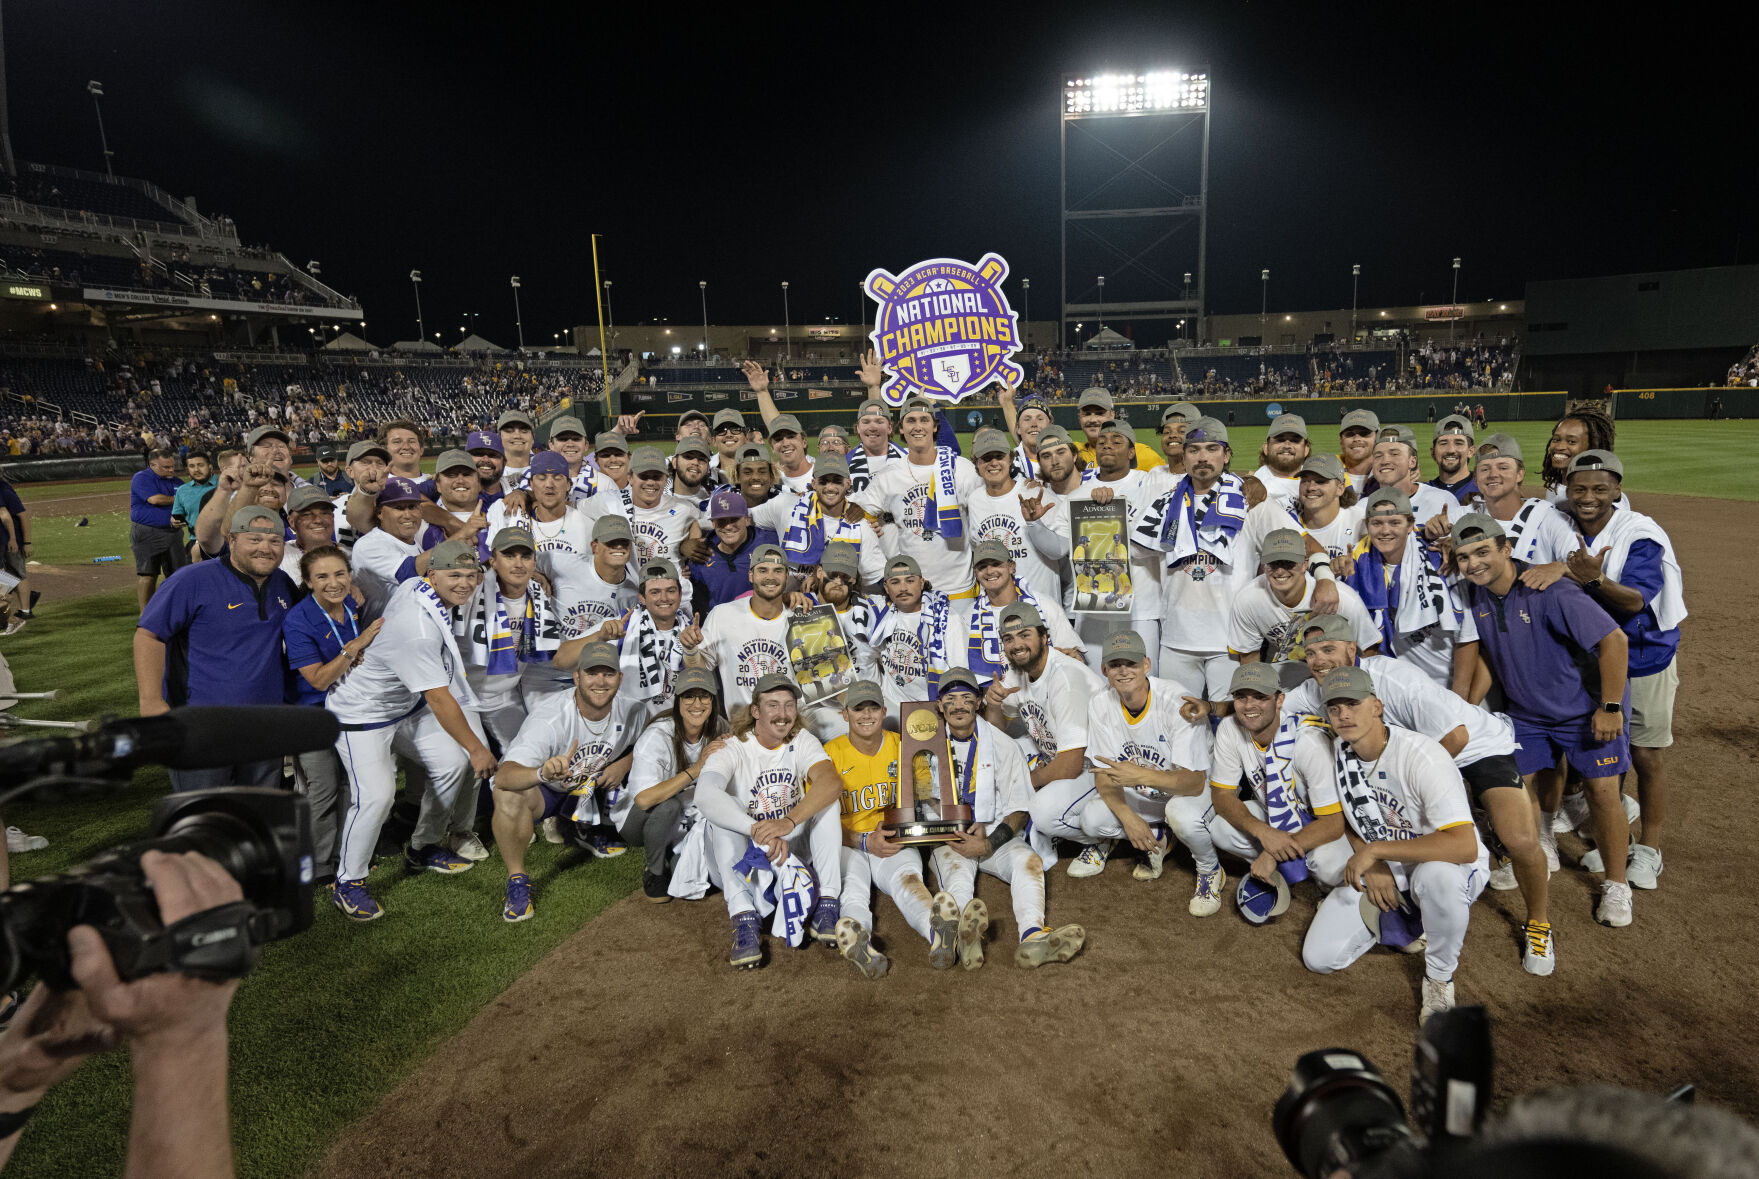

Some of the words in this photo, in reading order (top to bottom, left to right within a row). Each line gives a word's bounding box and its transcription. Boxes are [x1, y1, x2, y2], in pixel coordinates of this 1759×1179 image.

[896, 278, 915, 296] 2023
[917, 267, 938, 281] NCAA
[940, 266, 980, 285] BASEBALL
[9, 286, 42, 298] #MCWS
[896, 292, 988, 326] NATIONAL
[881, 316, 1011, 360] CHAMPIONS
[941, 360, 960, 383] LSU
[1638, 391, 1655, 400] 408
[480, 432, 492, 446] LSU
[939, 446, 950, 468] NCAA
[396, 479, 412, 494] LSU
[940, 468, 955, 496] 2023
[717, 497, 730, 511] LSU
[1082, 504, 1117, 513] ADVOCATE
[977, 517, 1021, 539] NATIONAL
[1011, 537, 1023, 546] 23
[657, 545, 669, 554] 23
[562, 615, 576, 626] 20
[1519, 609, 1531, 624] LSU
[737, 642, 789, 665] NATIONAL
[739, 664, 750, 673] 20
[776, 666, 788, 675] 23
[1596, 755, 1619, 767] LSU
[750, 772, 798, 798] NATIONAL
[748, 800, 759, 810] 20
[766, 787, 782, 808] LSU
